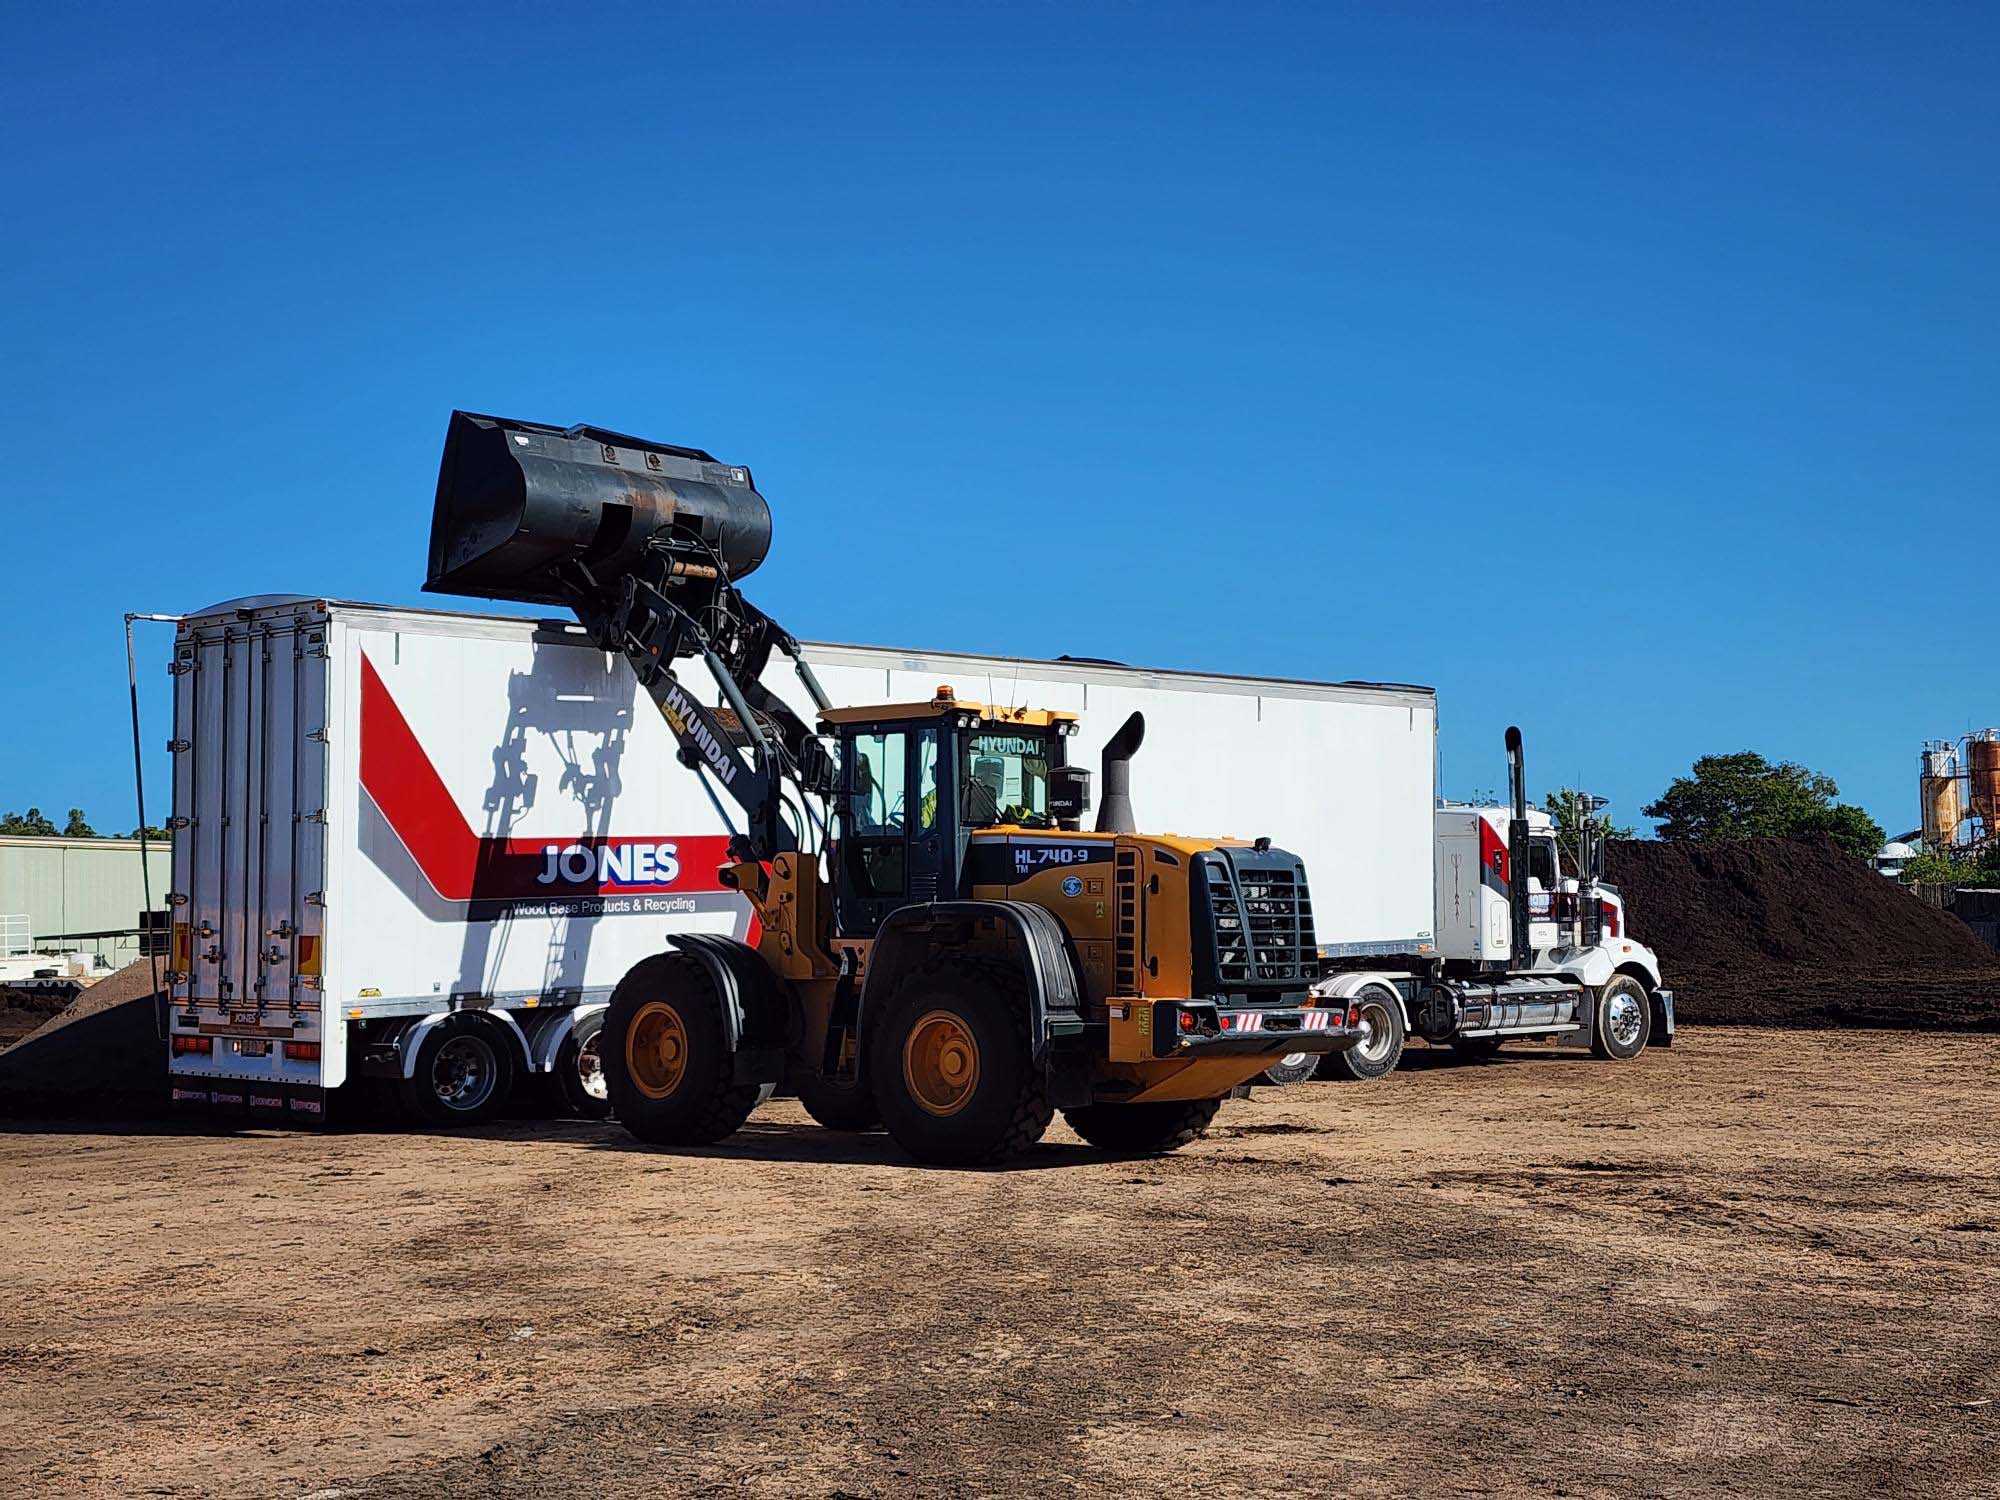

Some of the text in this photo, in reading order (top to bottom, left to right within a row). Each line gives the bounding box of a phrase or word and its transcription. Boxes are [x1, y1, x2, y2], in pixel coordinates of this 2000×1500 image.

[666, 685, 737, 785] HYUNDAI
[978, 736, 1039, 755] HYUNDAI
[537, 844, 680, 884] JONES
[1015, 849, 1089, 864] HL740-9
[1016, 865, 1029, 874] TM
[513, 897, 696, 916] Wood Base Products & Recycling
[234, 1013, 257, 1024] JONES
